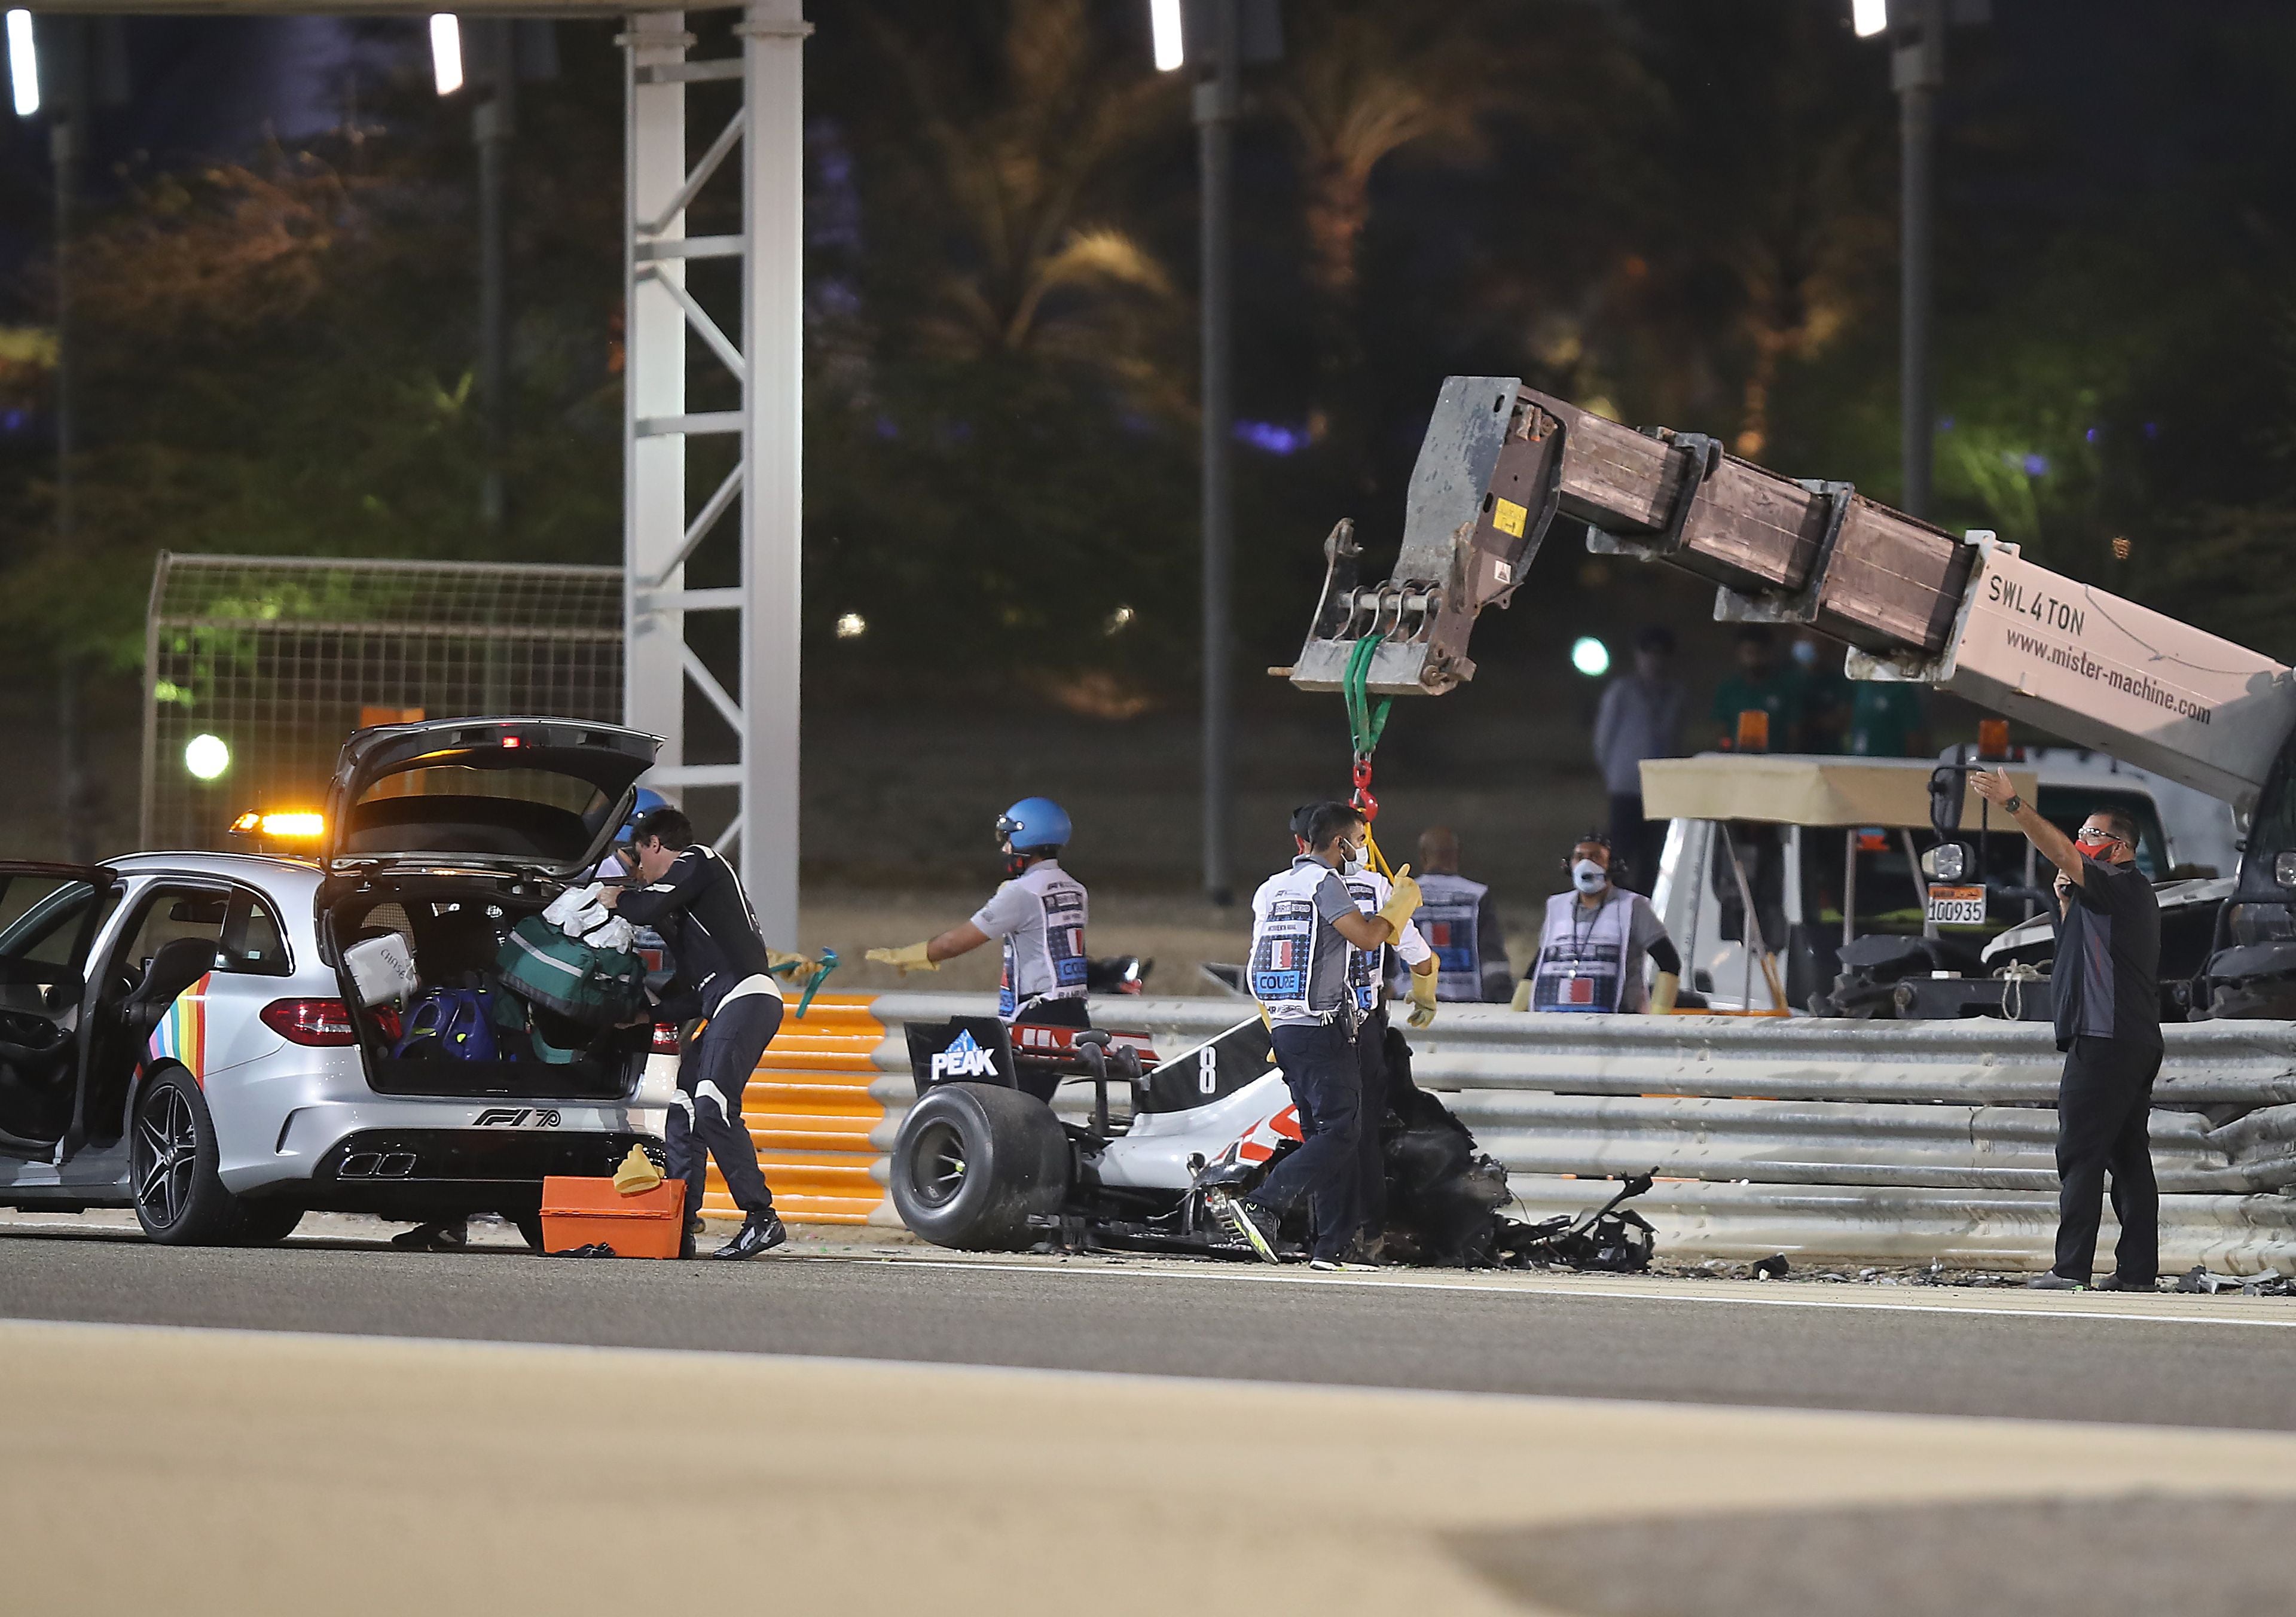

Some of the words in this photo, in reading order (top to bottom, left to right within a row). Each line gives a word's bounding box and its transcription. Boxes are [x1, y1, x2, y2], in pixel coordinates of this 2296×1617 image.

[1989, 574, 2026, 613] SWL
[2031, 591, 2042, 621] 4
[2048, 597, 2085, 636] TON
[2007, 628, 2211, 725] www.mister-machine.com
[1929, 902, 1981, 921] 100935
[380, 949, 405, 979] CHASE
[931, 1048, 999, 1081] PEAK
[1199, 1046, 1216, 1094] 8
